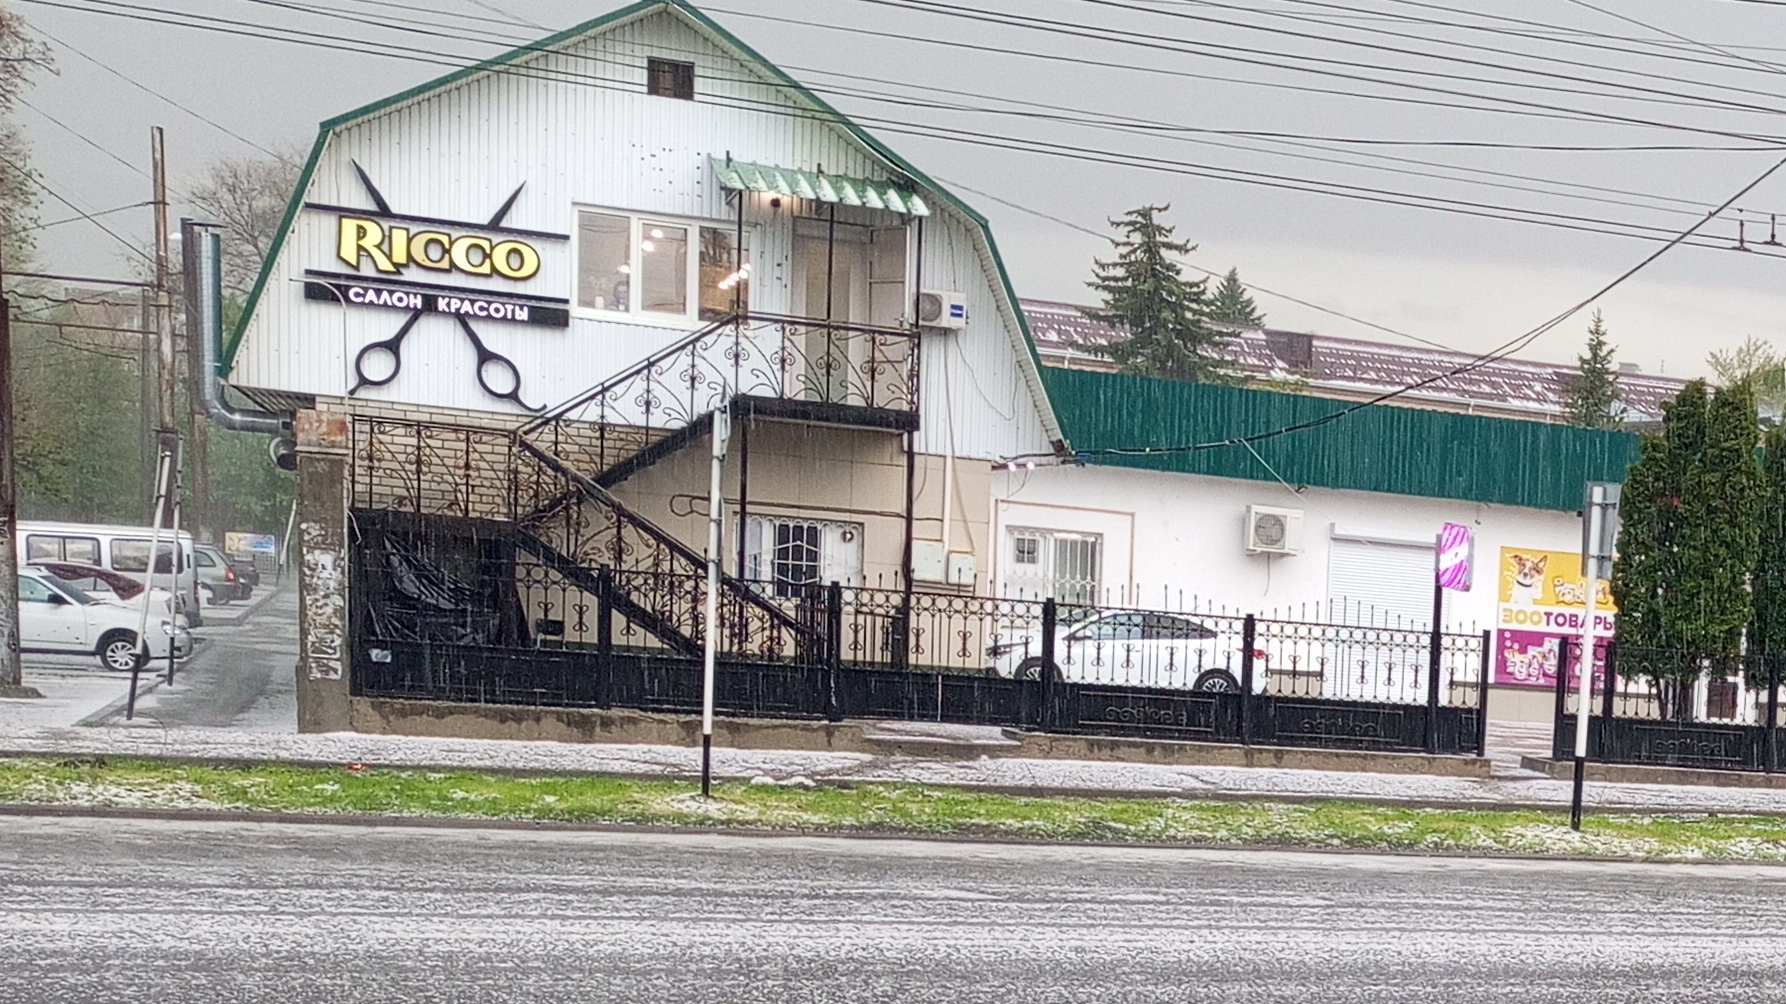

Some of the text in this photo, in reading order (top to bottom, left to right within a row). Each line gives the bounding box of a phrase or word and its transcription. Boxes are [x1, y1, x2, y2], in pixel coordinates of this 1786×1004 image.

[337, 215, 541, 281] RICCO
[348, 287, 529, 321] САЛОН КРАСОТЫ
